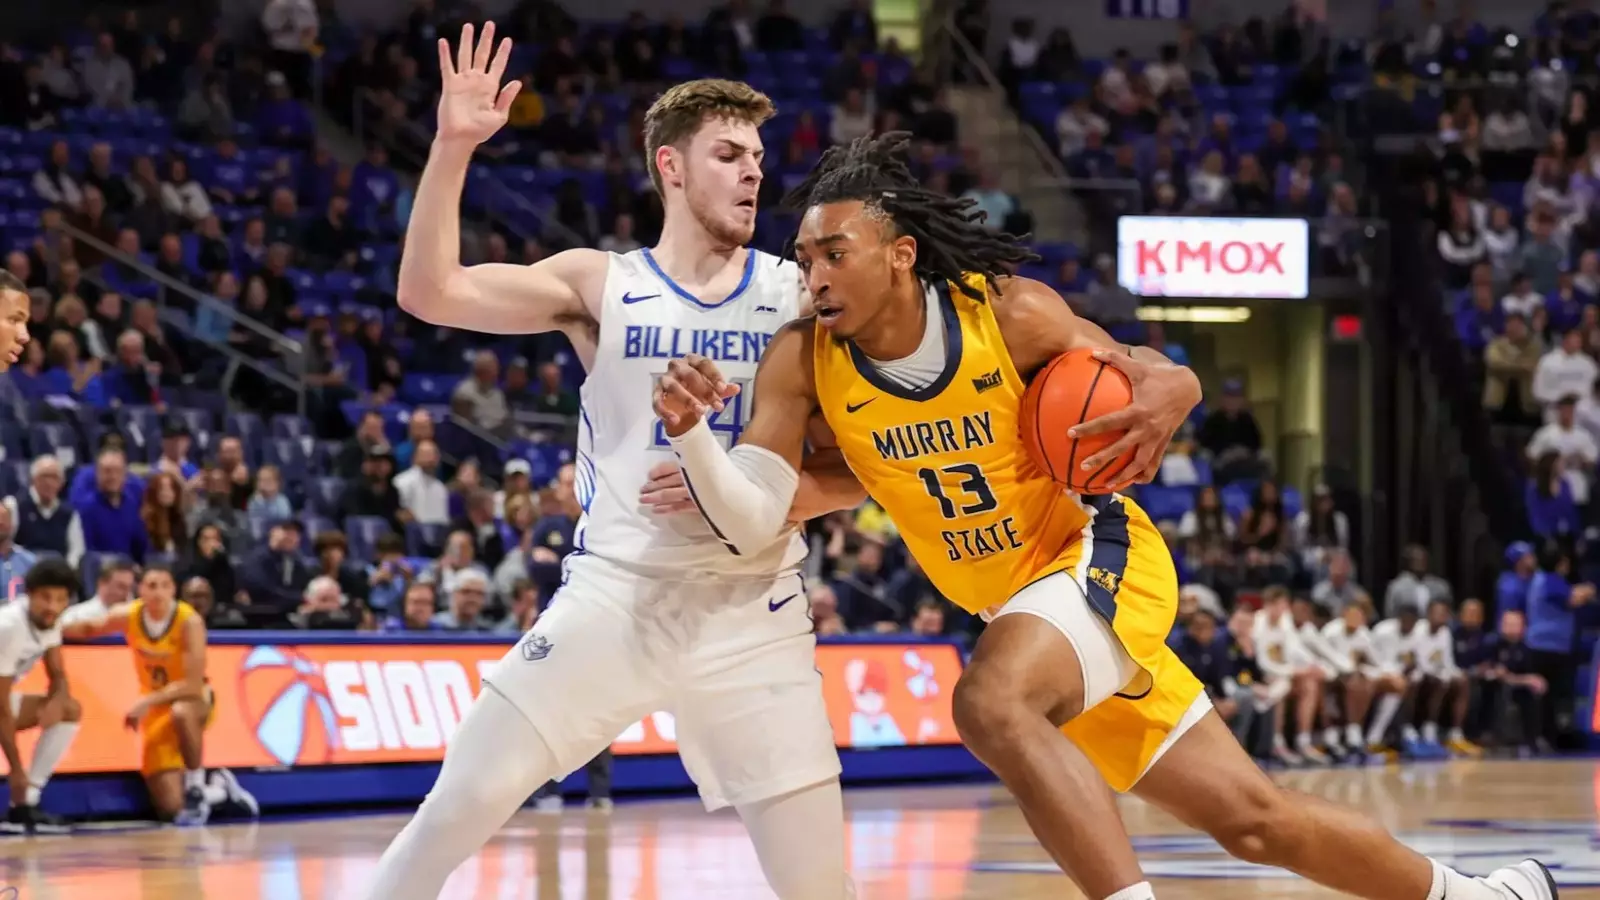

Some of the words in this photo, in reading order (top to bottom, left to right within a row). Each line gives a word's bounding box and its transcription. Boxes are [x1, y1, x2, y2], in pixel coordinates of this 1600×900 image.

[1136, 240, 1285, 276] KMOX
[872, 411, 994, 460] MURRAY
[918, 463, 997, 518] 13
[941, 516, 1023, 561] STATE
